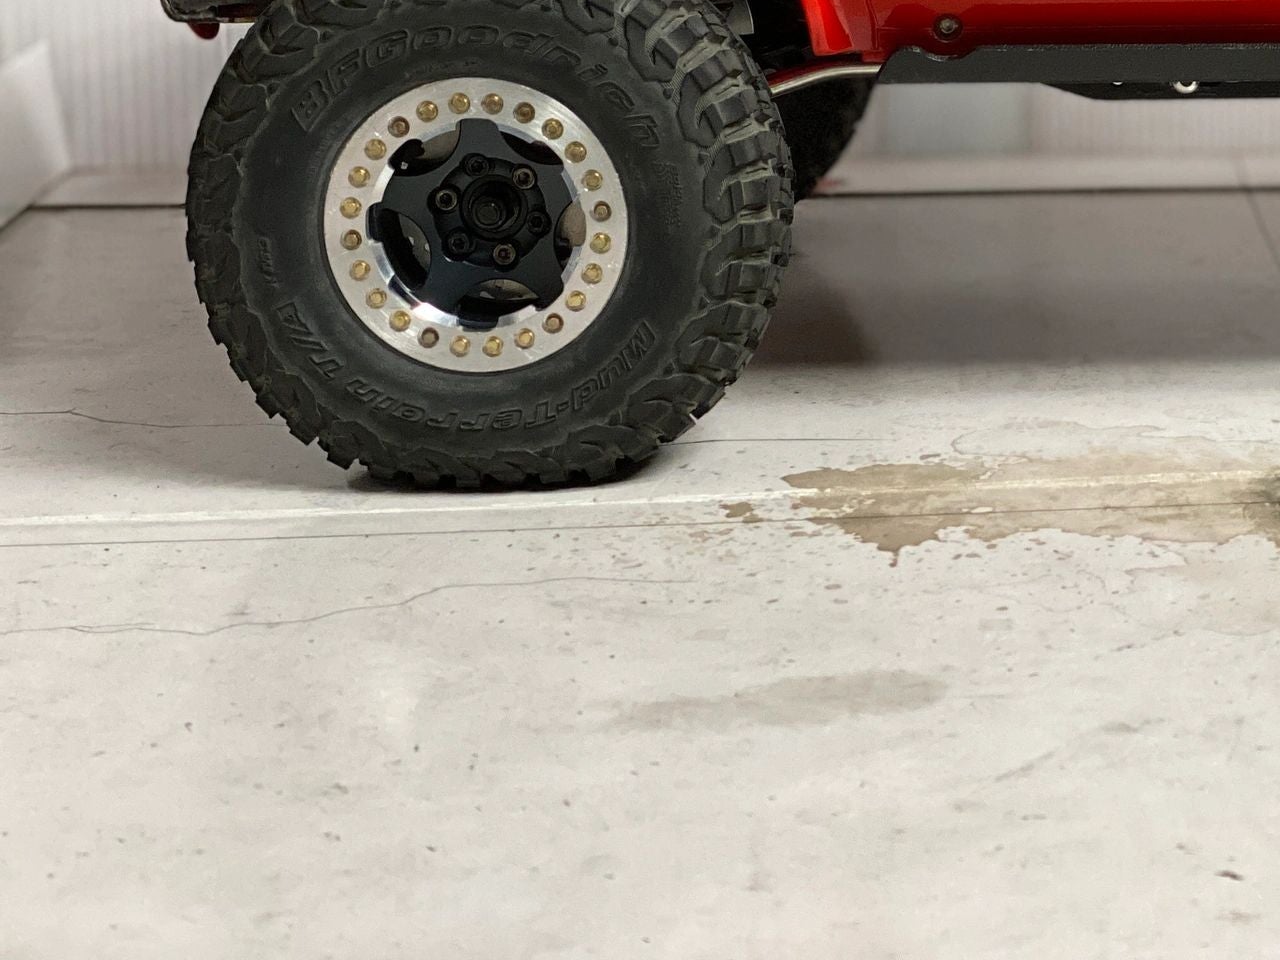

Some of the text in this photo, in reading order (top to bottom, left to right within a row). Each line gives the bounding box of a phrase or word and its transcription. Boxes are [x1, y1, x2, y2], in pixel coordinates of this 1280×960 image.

[291, 23, 660, 147] BFGoodrich
[273, 301, 345, 380] T/A
[345, 320, 656, 431] Mud-Terrain
